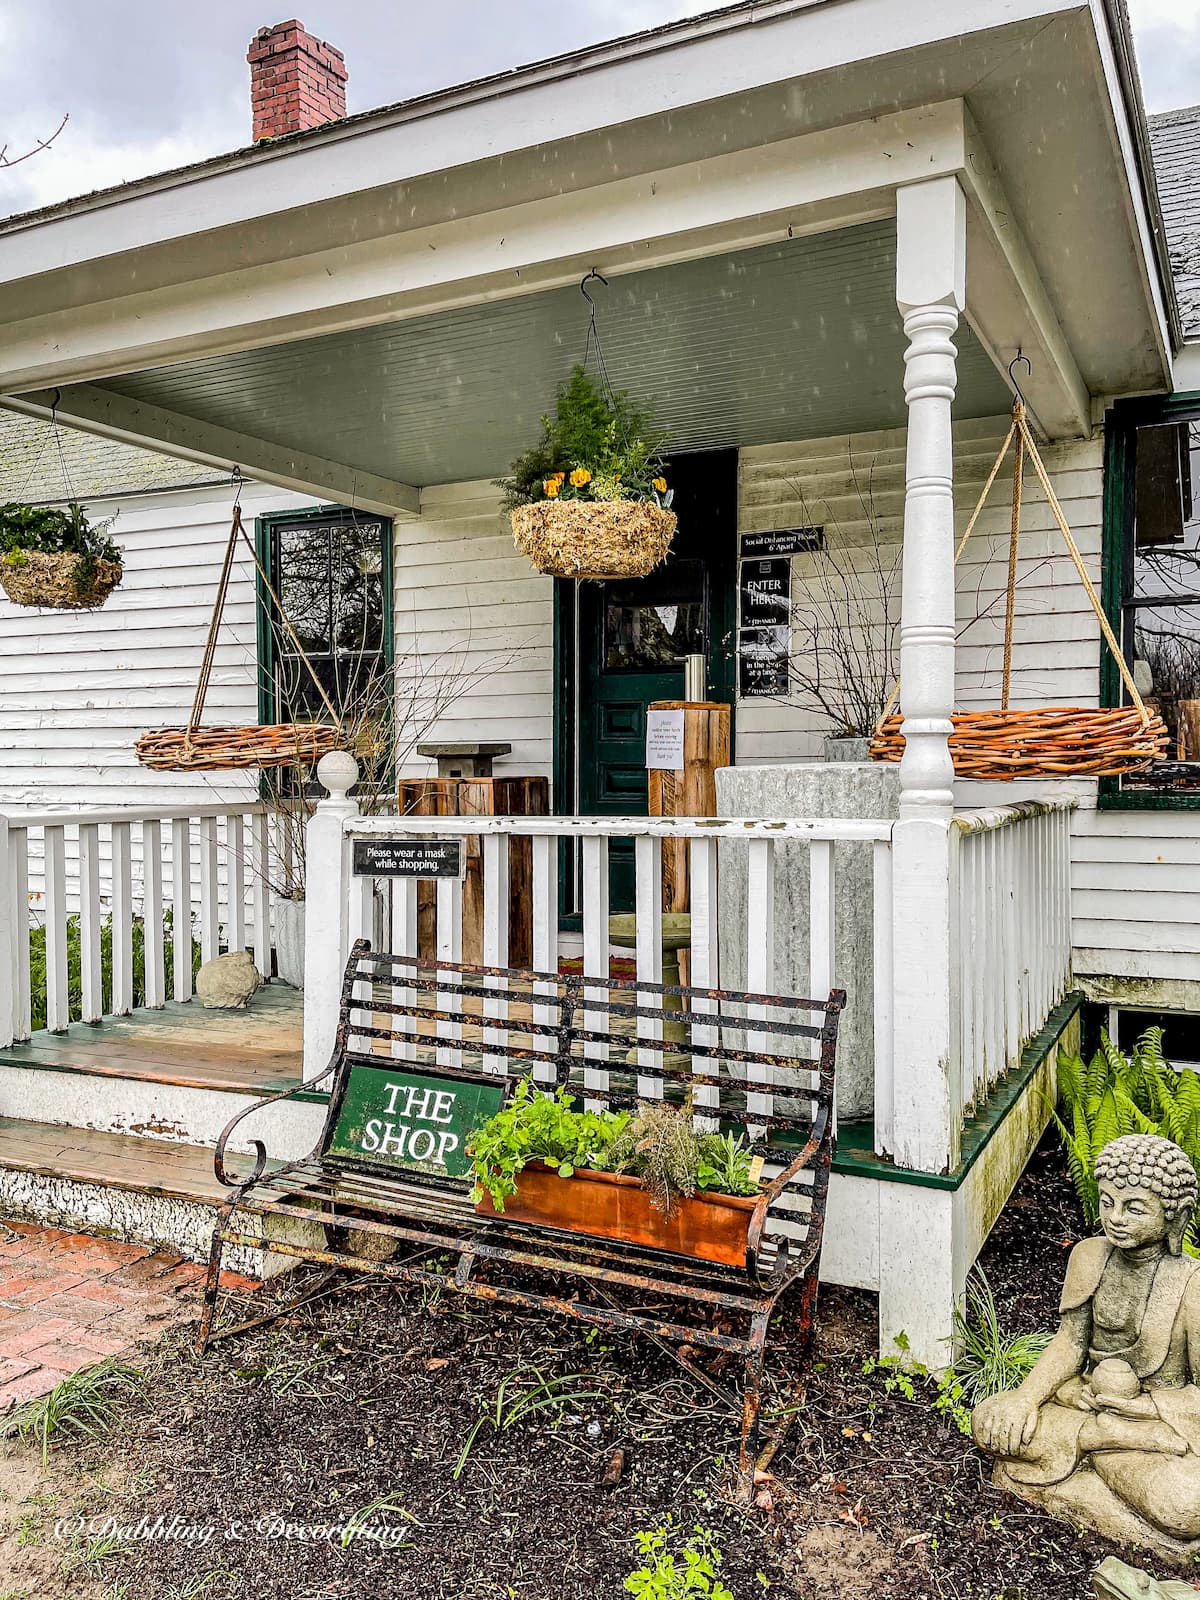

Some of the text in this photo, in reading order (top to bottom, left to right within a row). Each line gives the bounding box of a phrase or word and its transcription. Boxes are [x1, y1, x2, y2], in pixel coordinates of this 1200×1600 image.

[745, 536, 763, 546] Social
[764, 534, 797, 545] Distancing
[776, 543, 794, 552] Apart
[747, 579, 781, 592] ENTER
[750, 593, 777, 606] HERE
[746, 661, 753, 669] in
[754, 661, 765, 669] the
[367, 847, 446, 858] Please wear a mask
[374, 858, 440, 872] while shopping.
[383, 1082, 457, 1124] THE
[361, 1119, 459, 1165] SHOP
